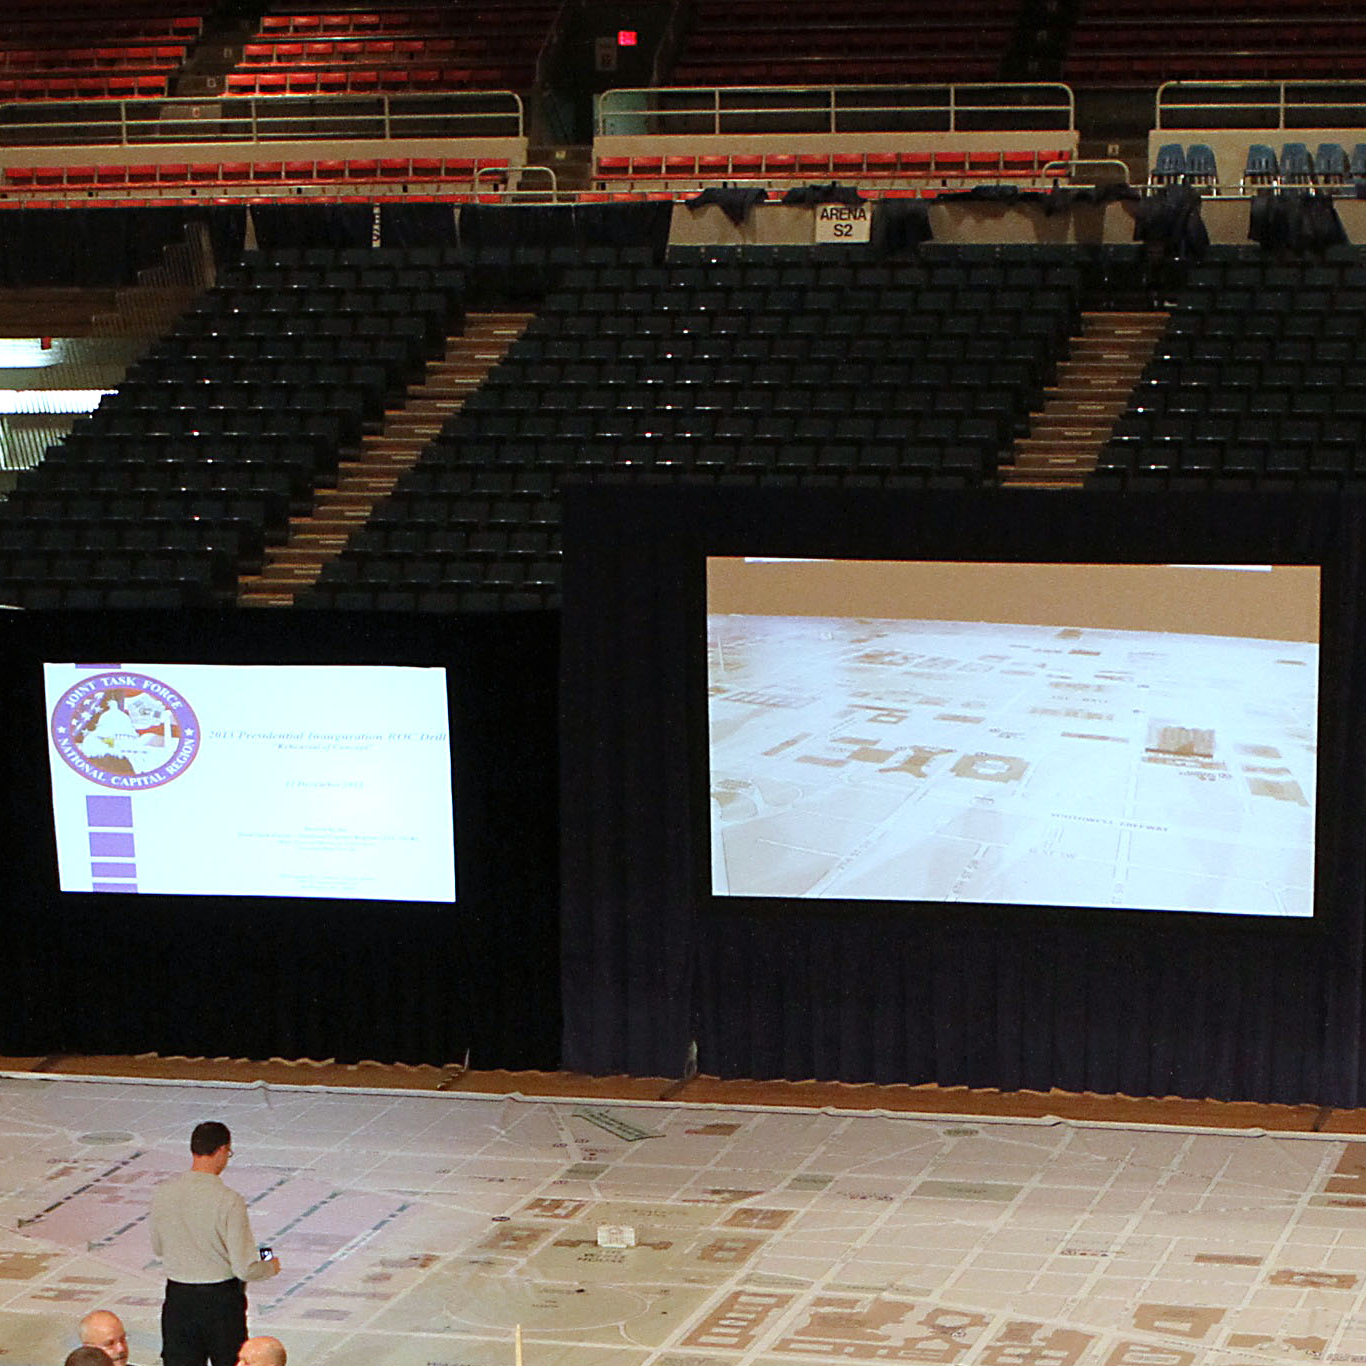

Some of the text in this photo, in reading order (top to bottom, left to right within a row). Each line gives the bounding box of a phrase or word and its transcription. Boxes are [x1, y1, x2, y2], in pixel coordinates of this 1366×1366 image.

[820, 208, 866, 221] ARENA
[833, 224, 853, 237] S2
[65, 675, 184, 711] JOINT TASK FORCE
[238, 730, 304, 740] Presidential
[307, 731, 383, 742] Inauguration
[419, 732, 446, 742] Drill
[58, 736, 196, 788] NATIONAL CAPITAL REGION
